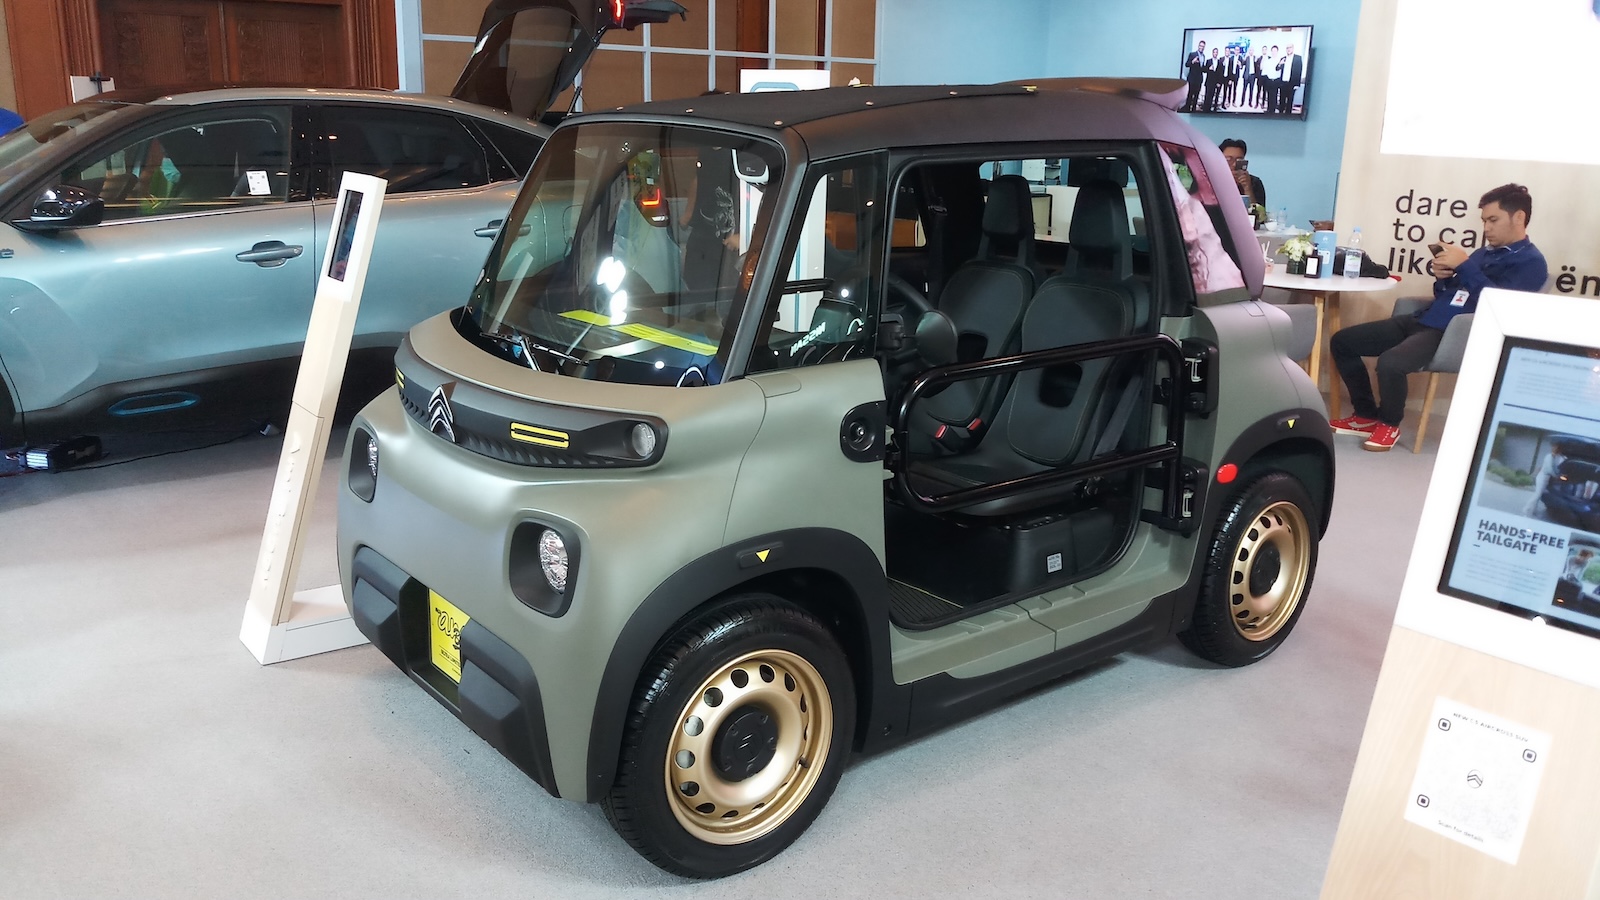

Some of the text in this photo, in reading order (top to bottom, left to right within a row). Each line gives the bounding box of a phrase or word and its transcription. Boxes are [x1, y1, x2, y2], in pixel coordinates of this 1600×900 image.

[1395, 189, 1468, 218] dare
[1392, 218, 1425, 243] to
[1477, 530, 1538, 555] TAILGATE
[1479, 519, 1565, 549] HANDS-FREE
